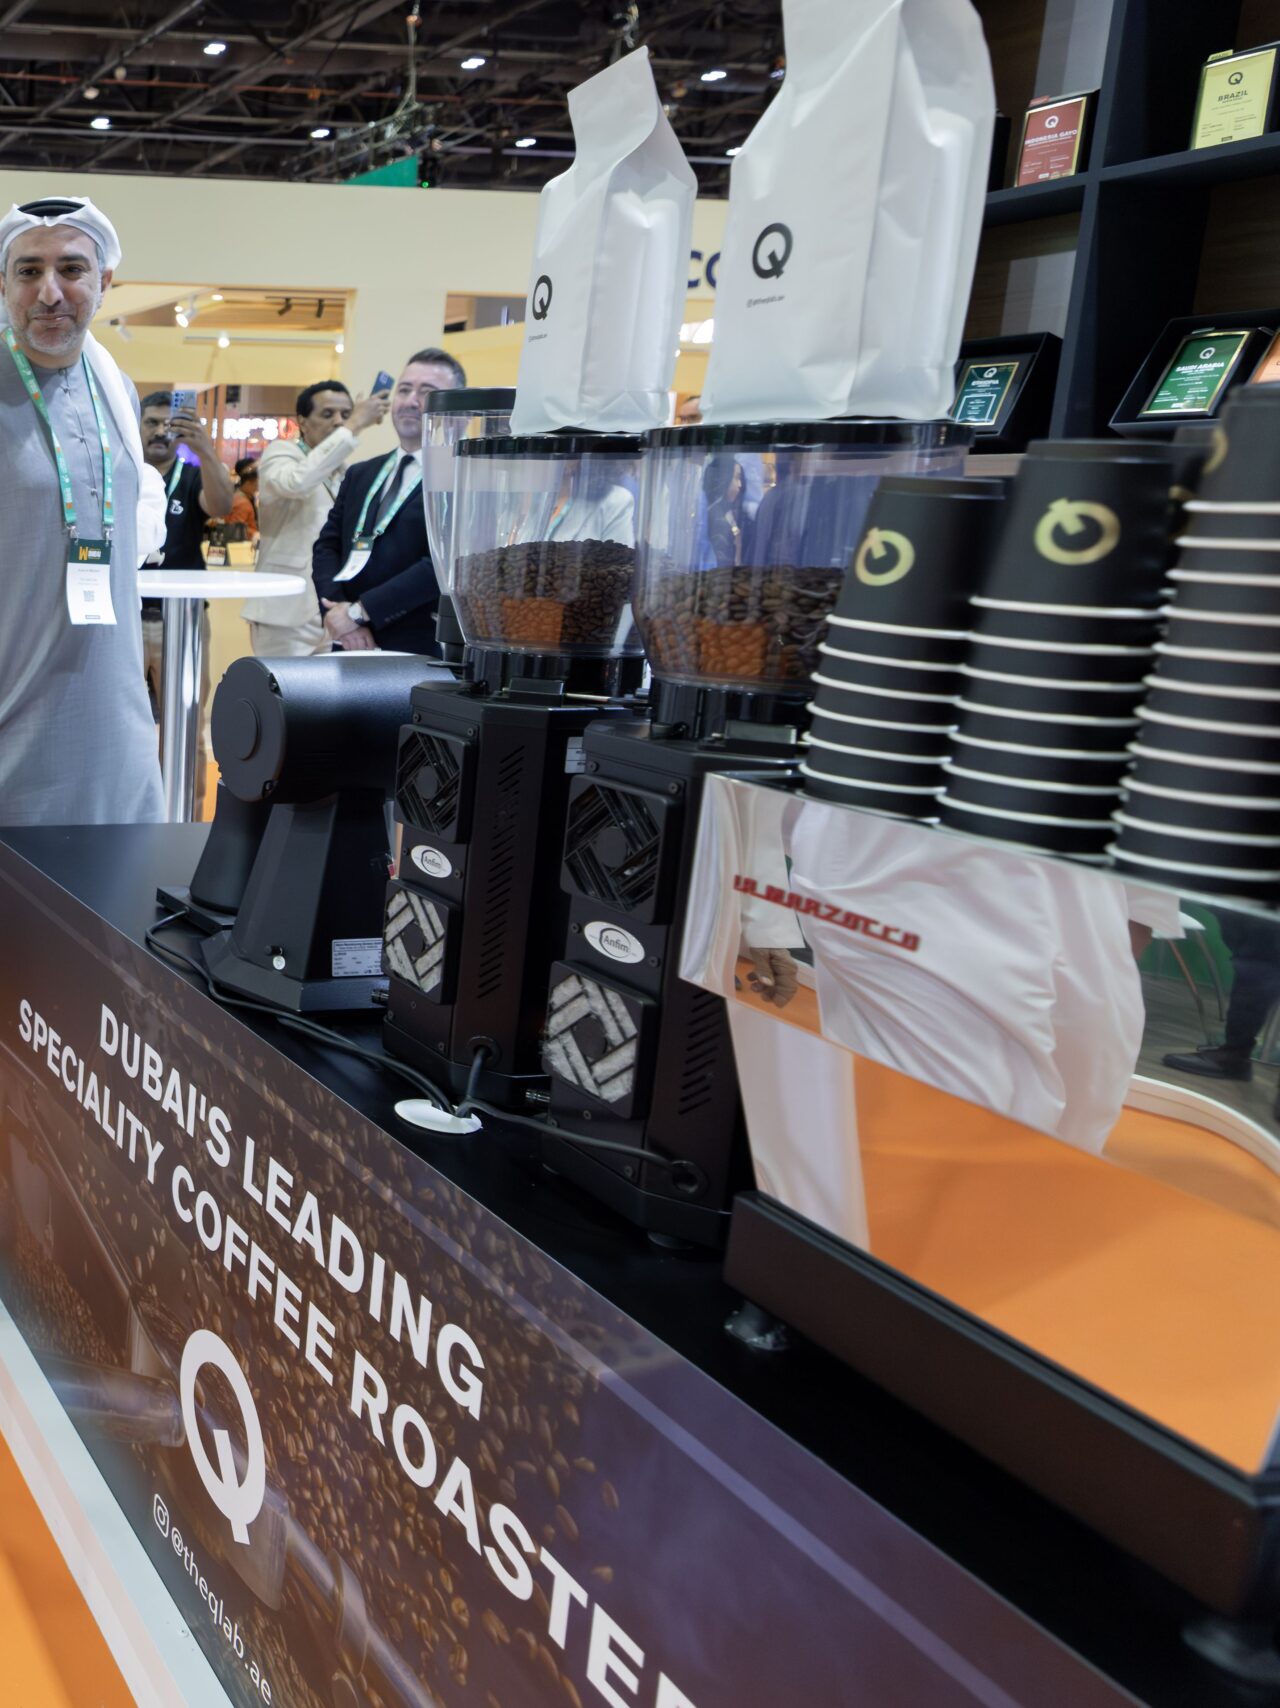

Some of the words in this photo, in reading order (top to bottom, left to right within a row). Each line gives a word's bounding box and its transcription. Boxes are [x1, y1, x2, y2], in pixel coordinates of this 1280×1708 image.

[1218, 90, 1248, 102] BRAZIL
[752, 222, 793, 279] Q
[532, 275, 552, 320] Q
[1175, 364, 1197, 372] SAUDI
[1197, 362, 1224, 370] ARABIA
[603, 934, 629, 953] Anfim
[19, 999, 164, 1184] SPECIALITY
[172, 1165, 335, 1387] COFFEE
[100, 1003, 232, 1167] DUBAI'S
[243, 1135, 485, 1421] LEADING
[180, 1329, 266, 1545] Q
[171, 1527, 271, 1705] @theqlab.ae
